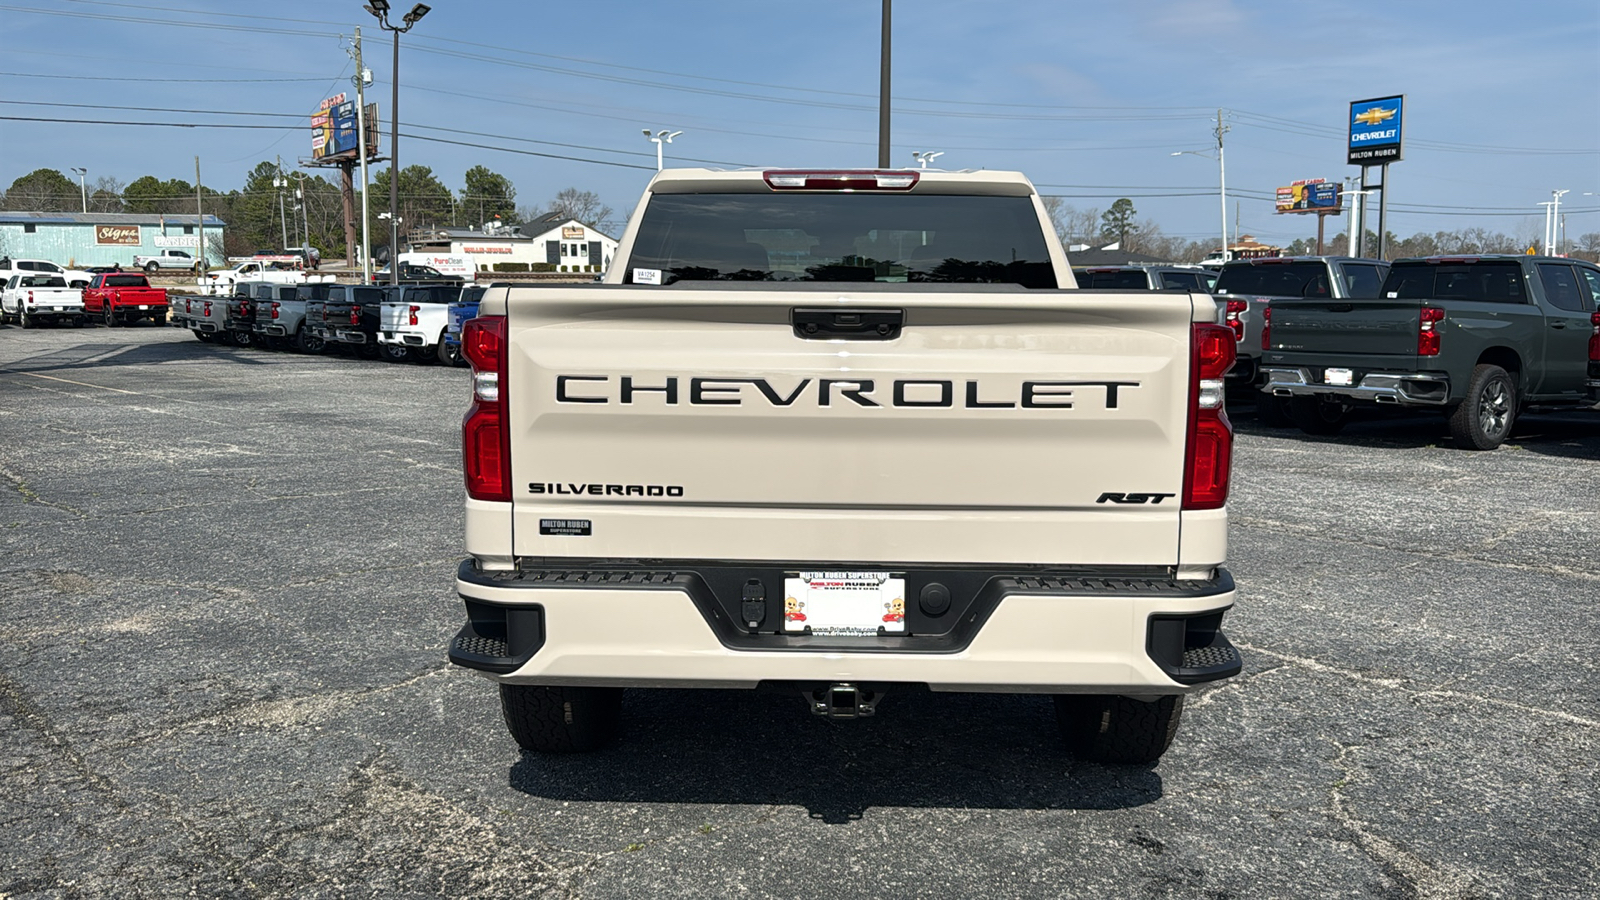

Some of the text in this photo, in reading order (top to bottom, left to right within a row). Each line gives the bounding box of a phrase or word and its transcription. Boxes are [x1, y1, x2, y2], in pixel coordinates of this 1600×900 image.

[1351, 129, 1397, 142] CHEVROLET
[1350, 148, 1397, 159] MILTON RUBEN
[98, 227, 137, 241] Signs
[434, 257, 463, 265] PuroClean
[556, 375, 1139, 409] CHEVROLET
[528, 483, 684, 497] SILVERADO
[1096, 492, 1176, 504] RST
[541, 520, 589, 529] MILTON RUBEN
[800, 571, 890, 579] MILTON RUBEN SUPERSTORE
